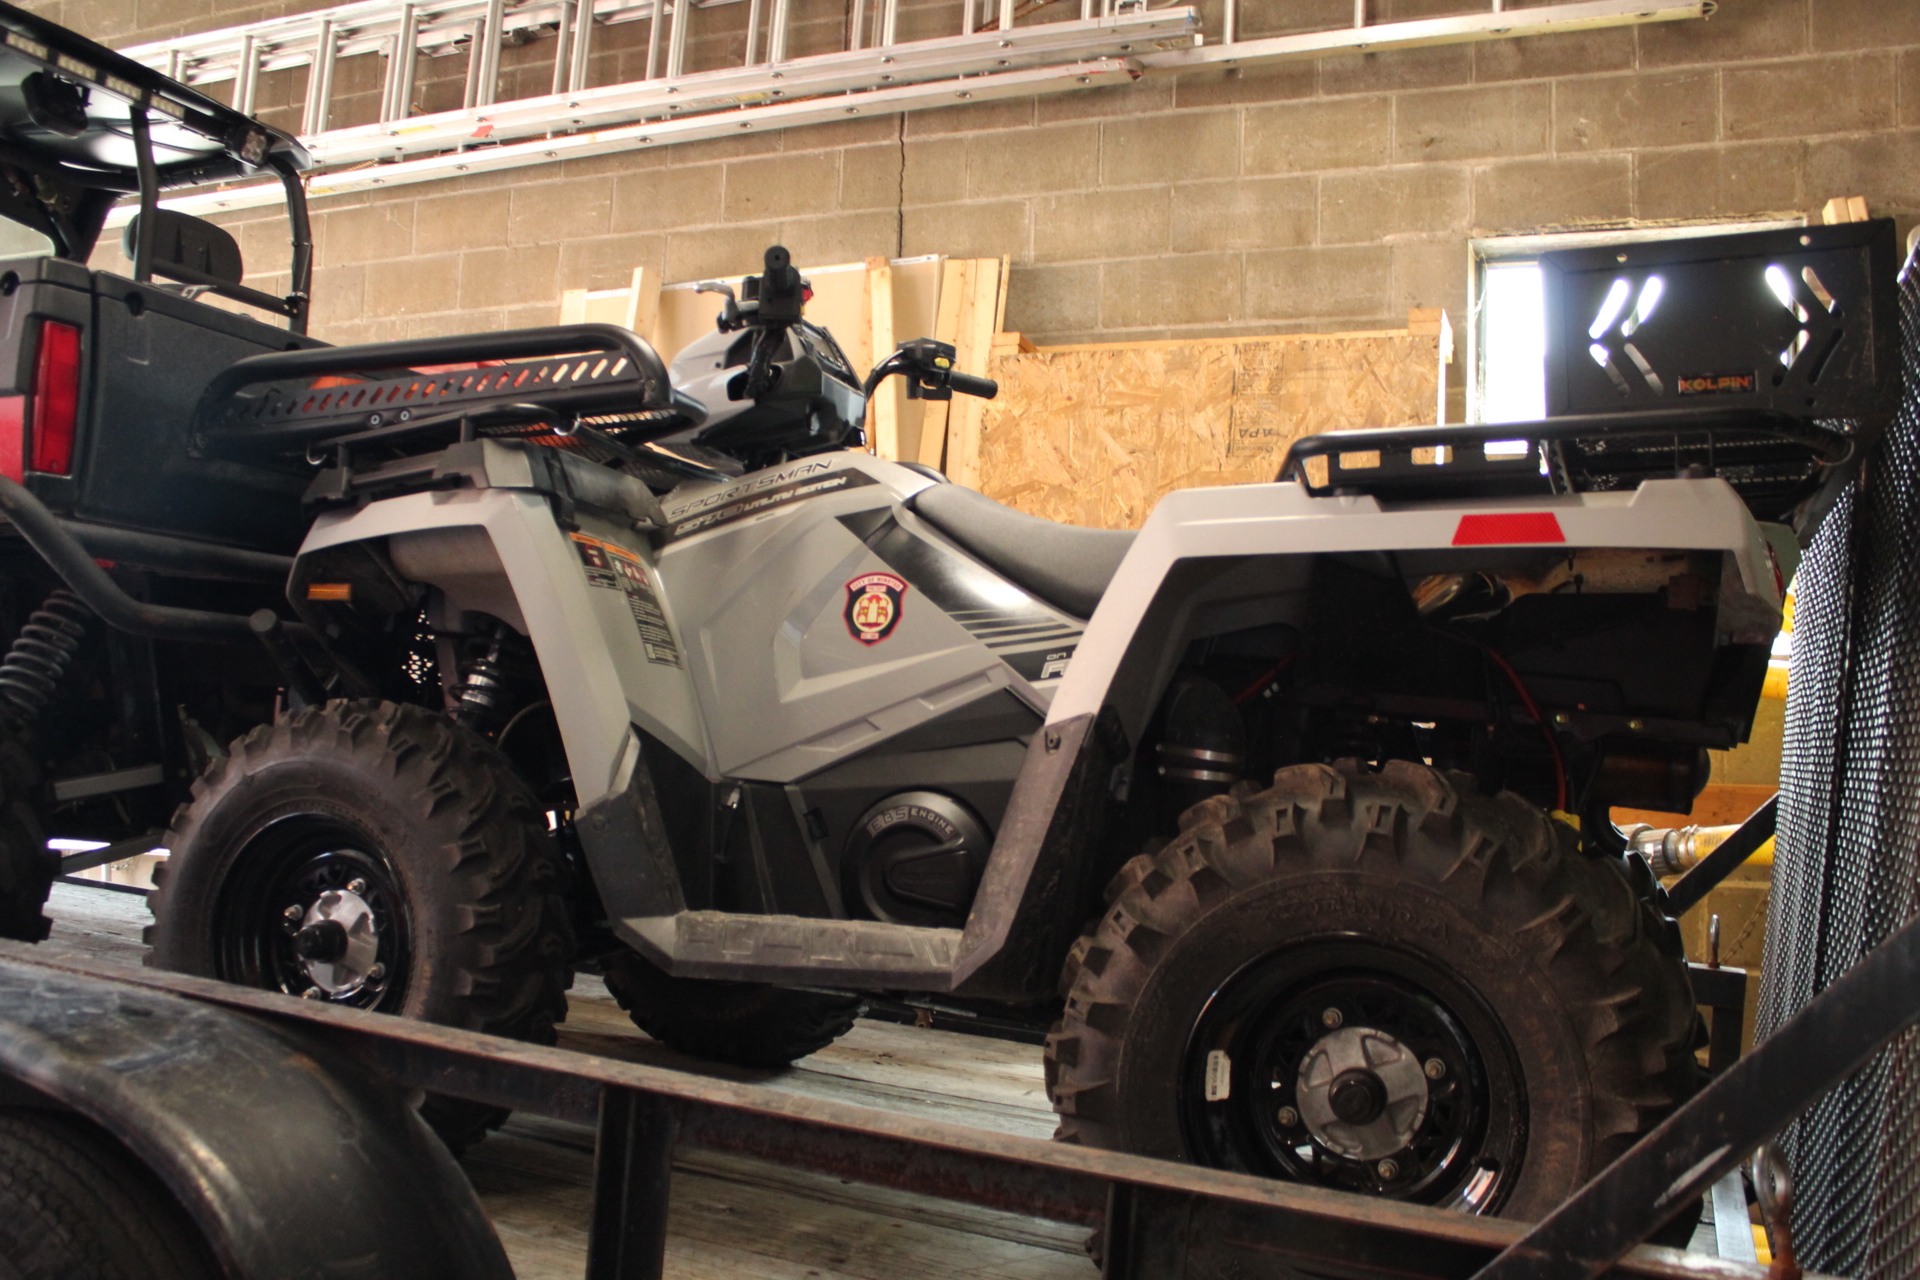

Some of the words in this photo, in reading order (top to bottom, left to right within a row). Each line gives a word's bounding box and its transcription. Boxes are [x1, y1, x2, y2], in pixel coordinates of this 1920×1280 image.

[1680, 376, 1750, 391] KOLPIN
[669, 459, 834, 519] SPORTSMAN
[910, 807, 954, 835] ENGINE
